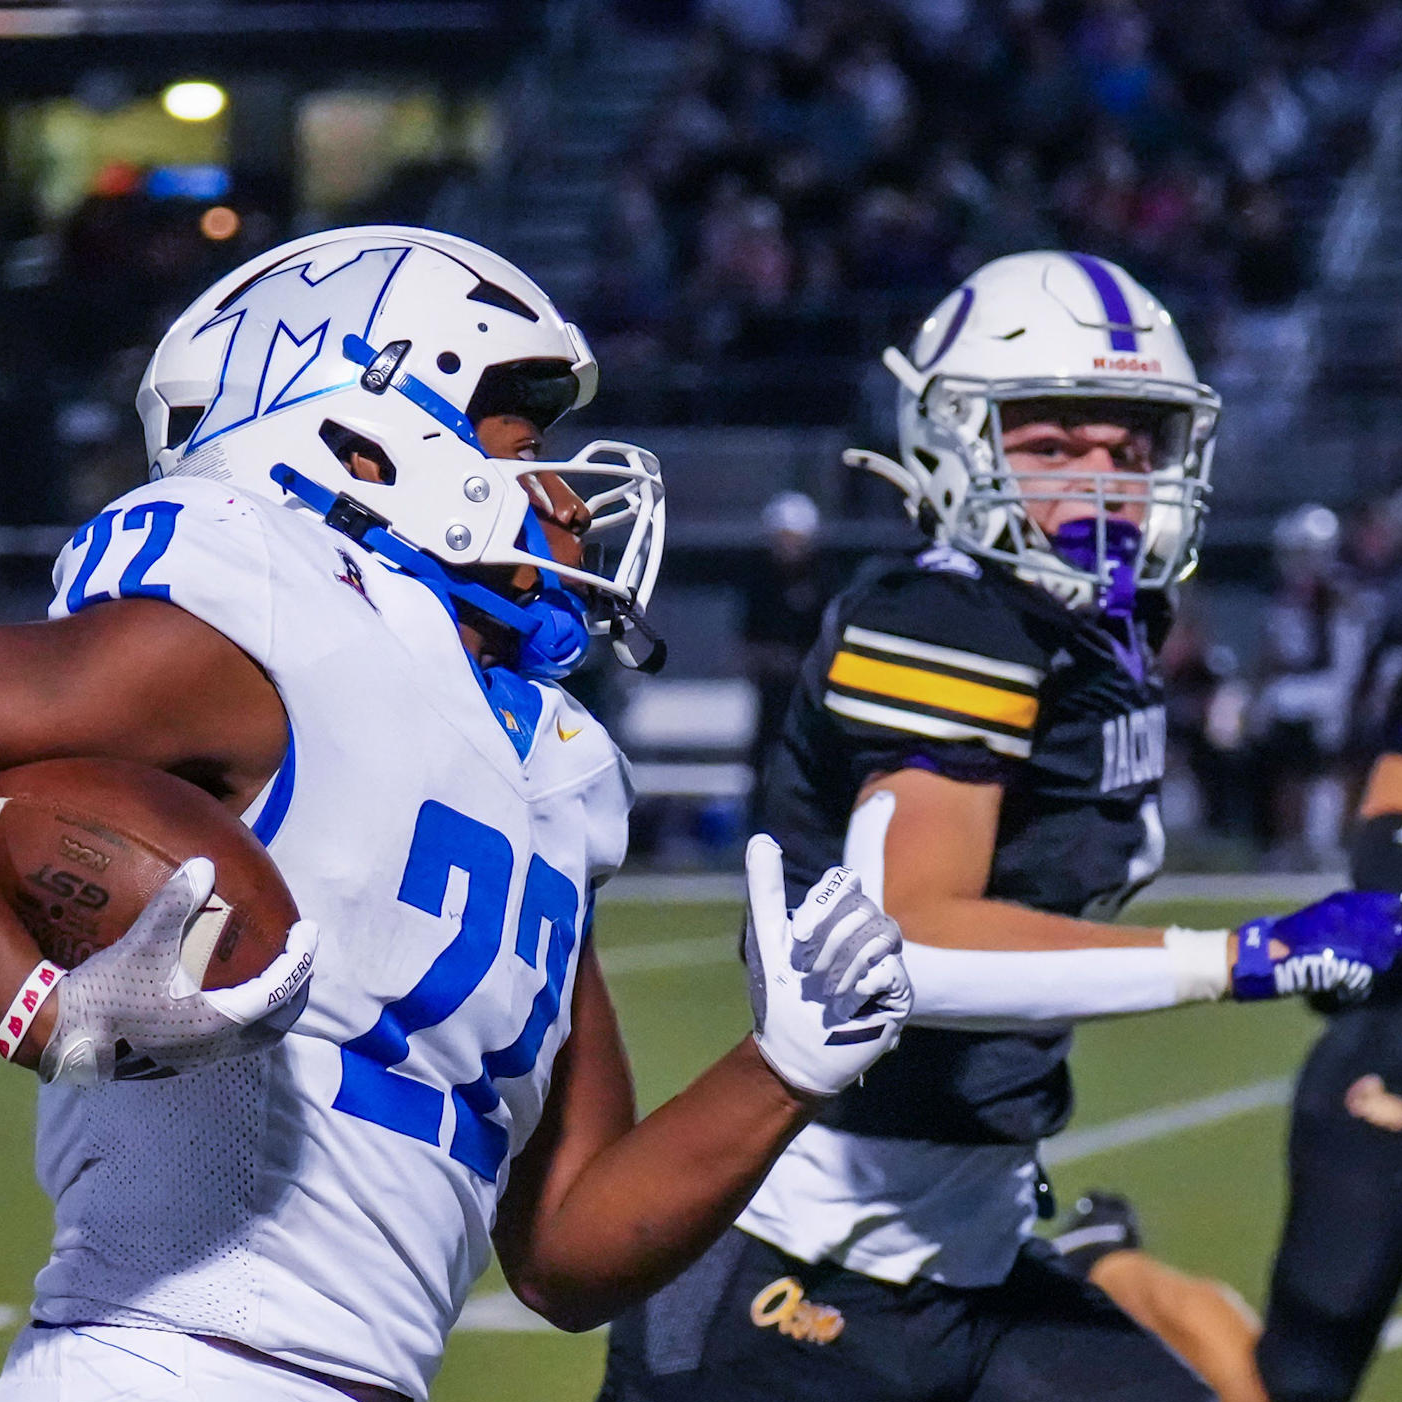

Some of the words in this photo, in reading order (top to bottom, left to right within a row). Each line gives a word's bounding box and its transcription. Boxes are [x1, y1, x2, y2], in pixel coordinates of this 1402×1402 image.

[185, 246, 411, 456] M
[1092, 357, 1162, 374] Riddell
[67, 500, 184, 613] 22
[814, 865, 854, 906] IZERO
[266, 951, 313, 1008] ADIZERO
[331, 798, 579, 1183] 22
